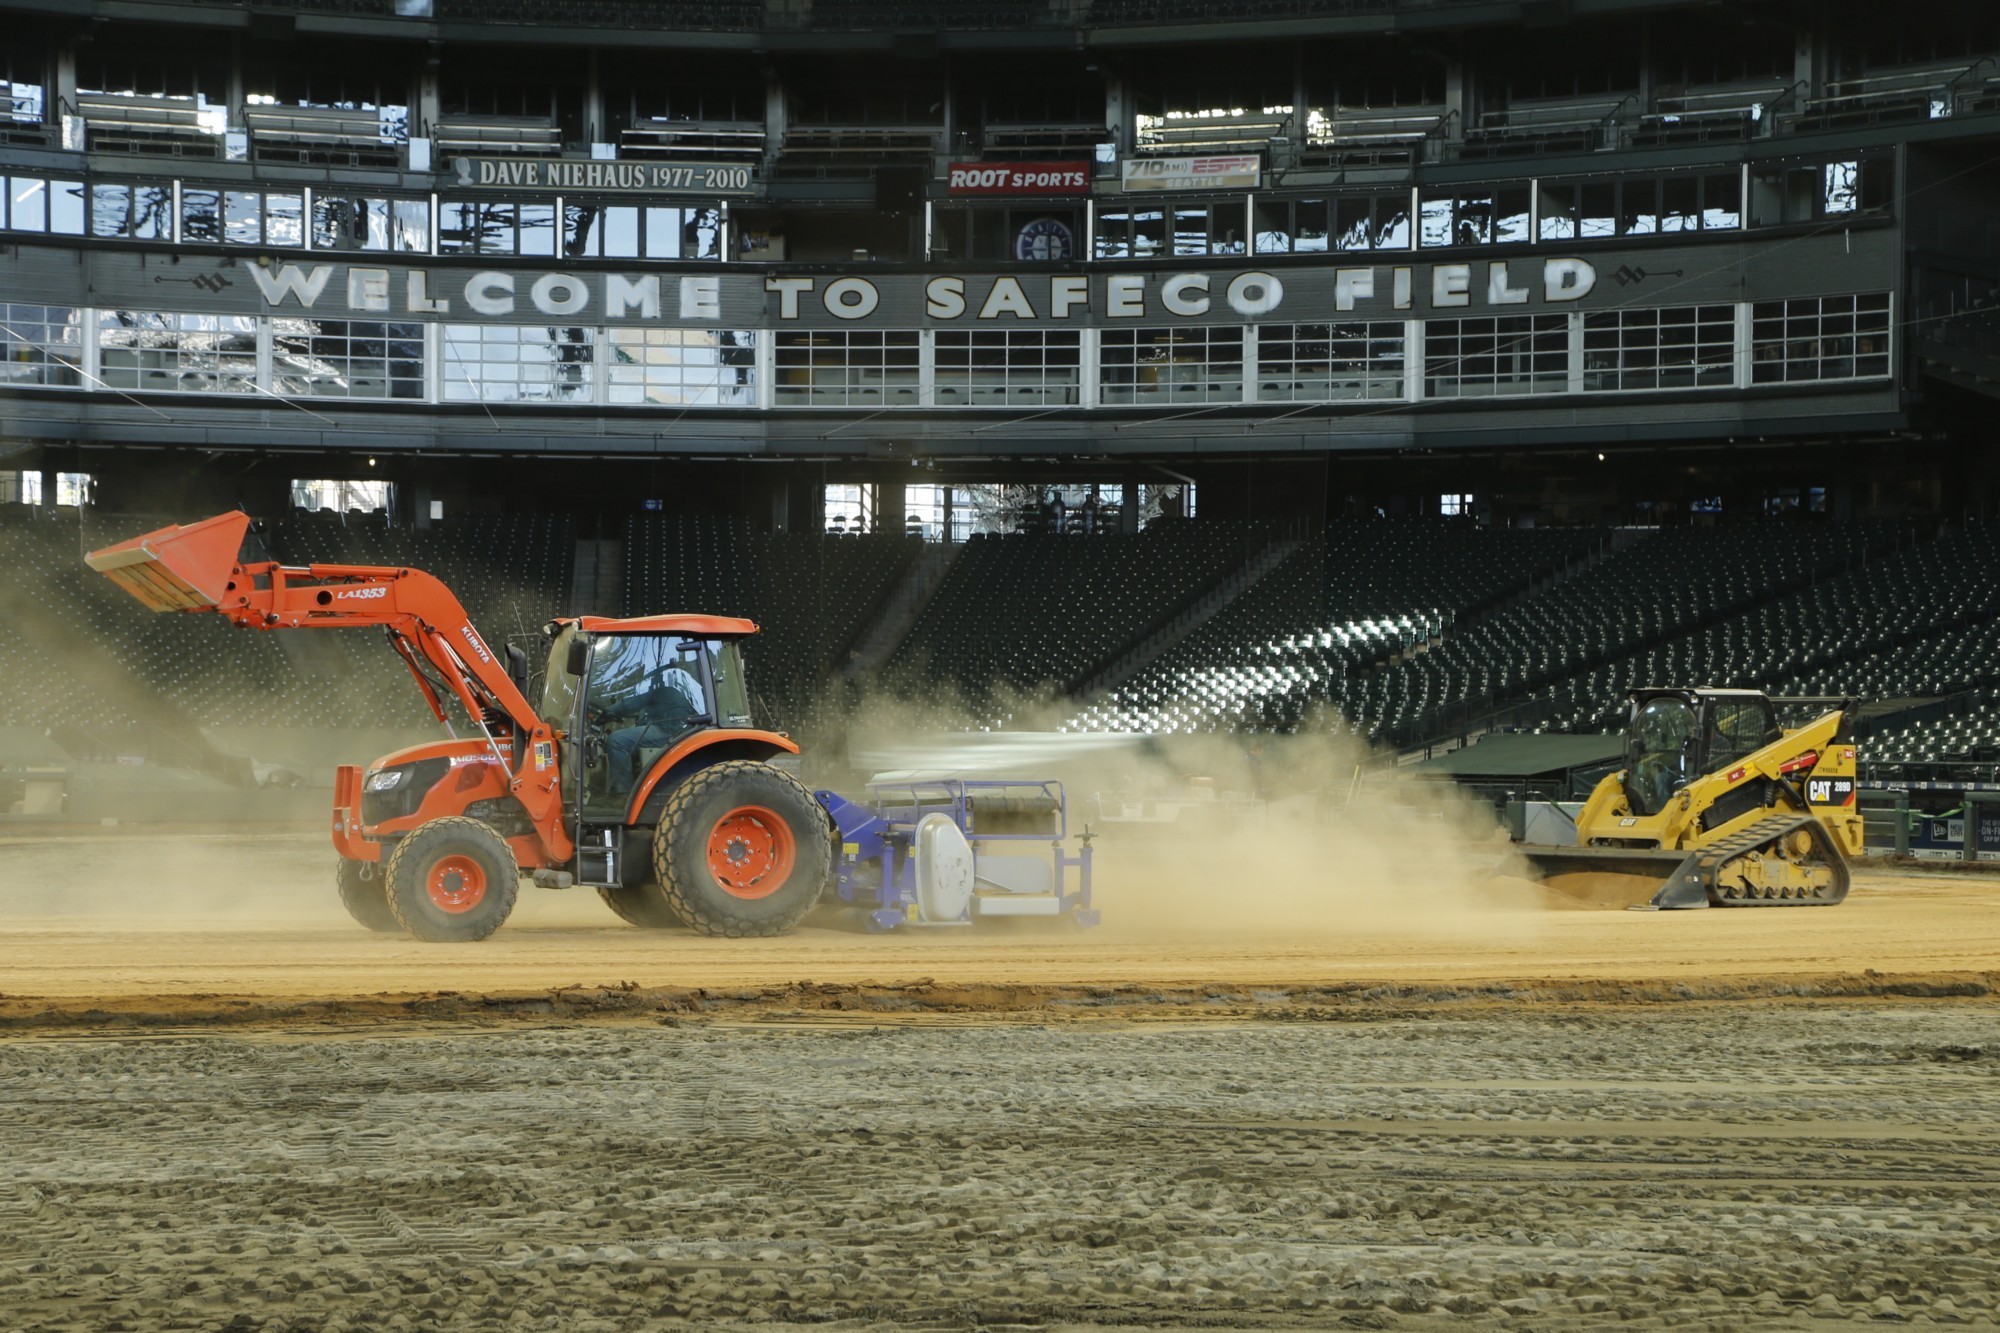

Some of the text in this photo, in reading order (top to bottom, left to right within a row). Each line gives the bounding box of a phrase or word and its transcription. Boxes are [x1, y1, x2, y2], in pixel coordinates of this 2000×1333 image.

[480, 161, 748, 189] DAVE NIEHAUS 1977-2010
[1192, 157, 1258, 174] ESPN
[950, 170, 1084, 188] ROOT SPORTS
[1166, 176, 1224, 188] SEATTLE
[245, 257, 1597, 321] WELCOME TO SAFECO FIELD
[337, 587, 387, 600] LA1353
[460, 626, 490, 664] KUBOTA
[1810, 780, 1831, 802] CAT
